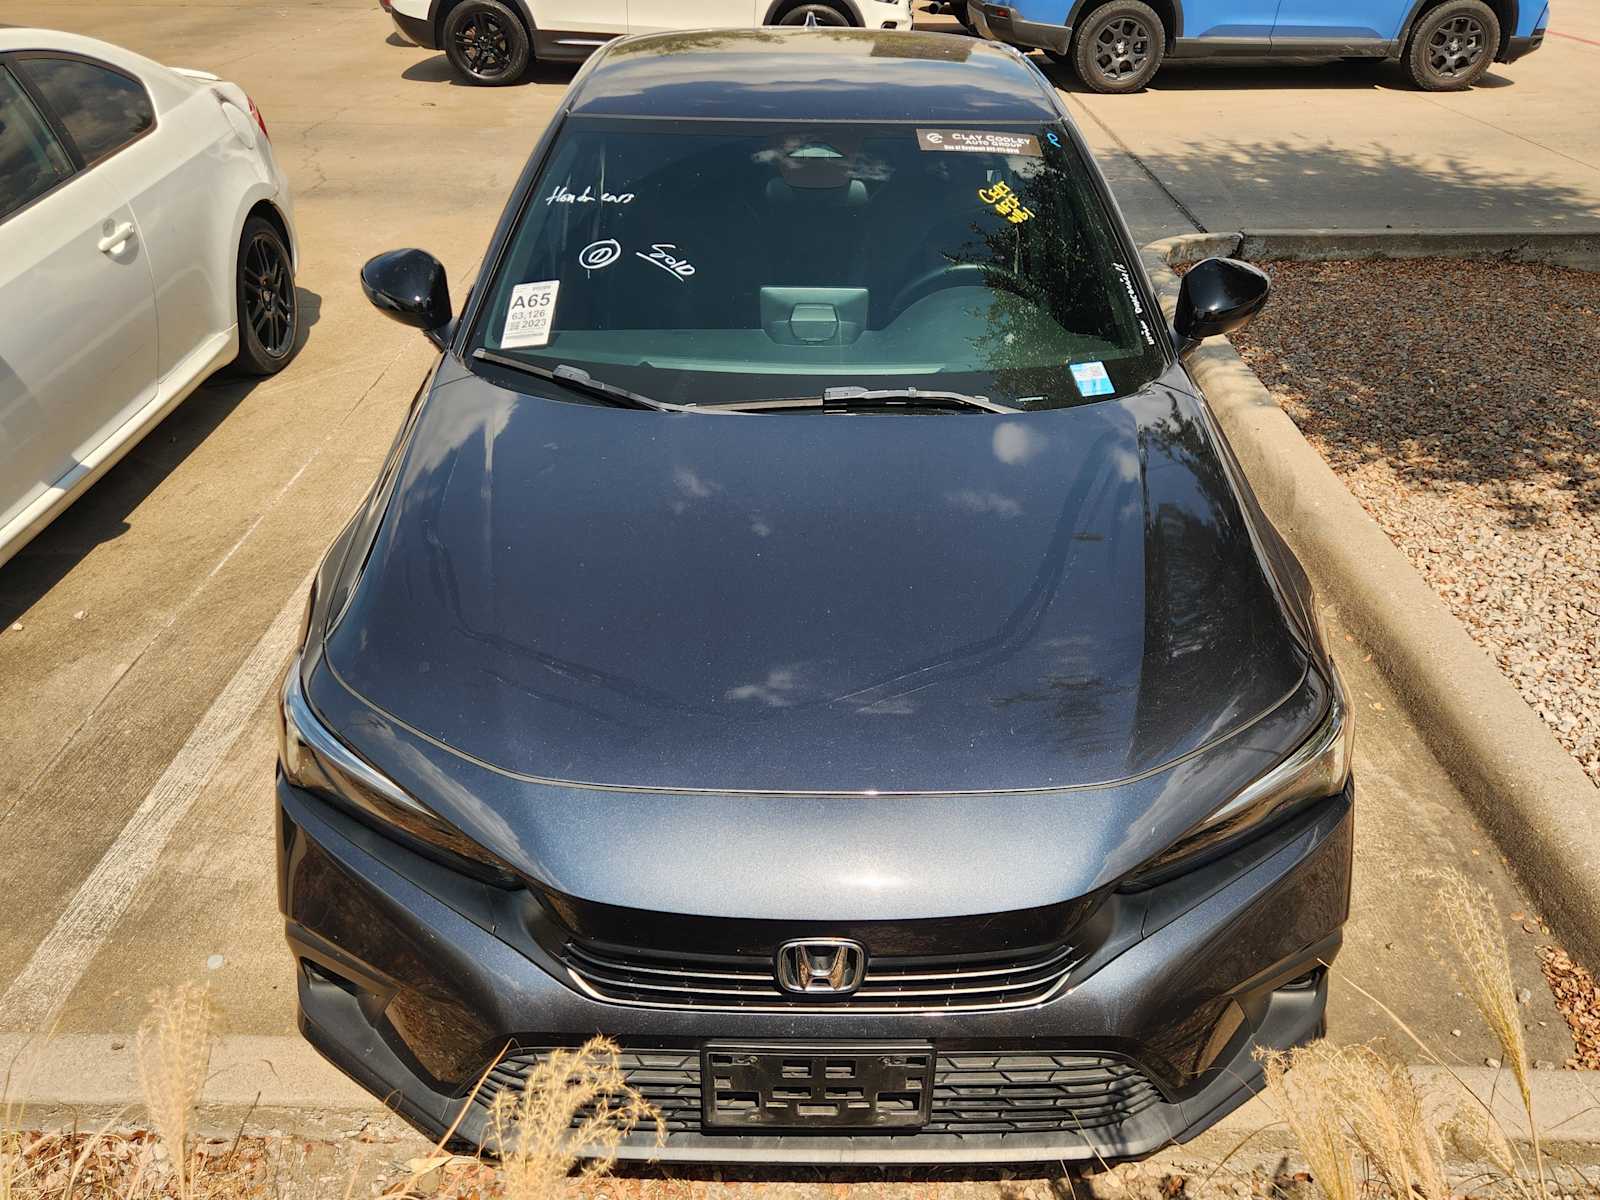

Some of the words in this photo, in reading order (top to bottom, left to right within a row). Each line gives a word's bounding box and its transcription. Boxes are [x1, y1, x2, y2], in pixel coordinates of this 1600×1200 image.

[952, 133, 982, 141] CLAY
[985, 134, 1031, 145] COOLEY
[991, 140, 1022, 148] GROUP
[511, 292, 551, 310] A65
[521, 318, 547, 329] 2023
